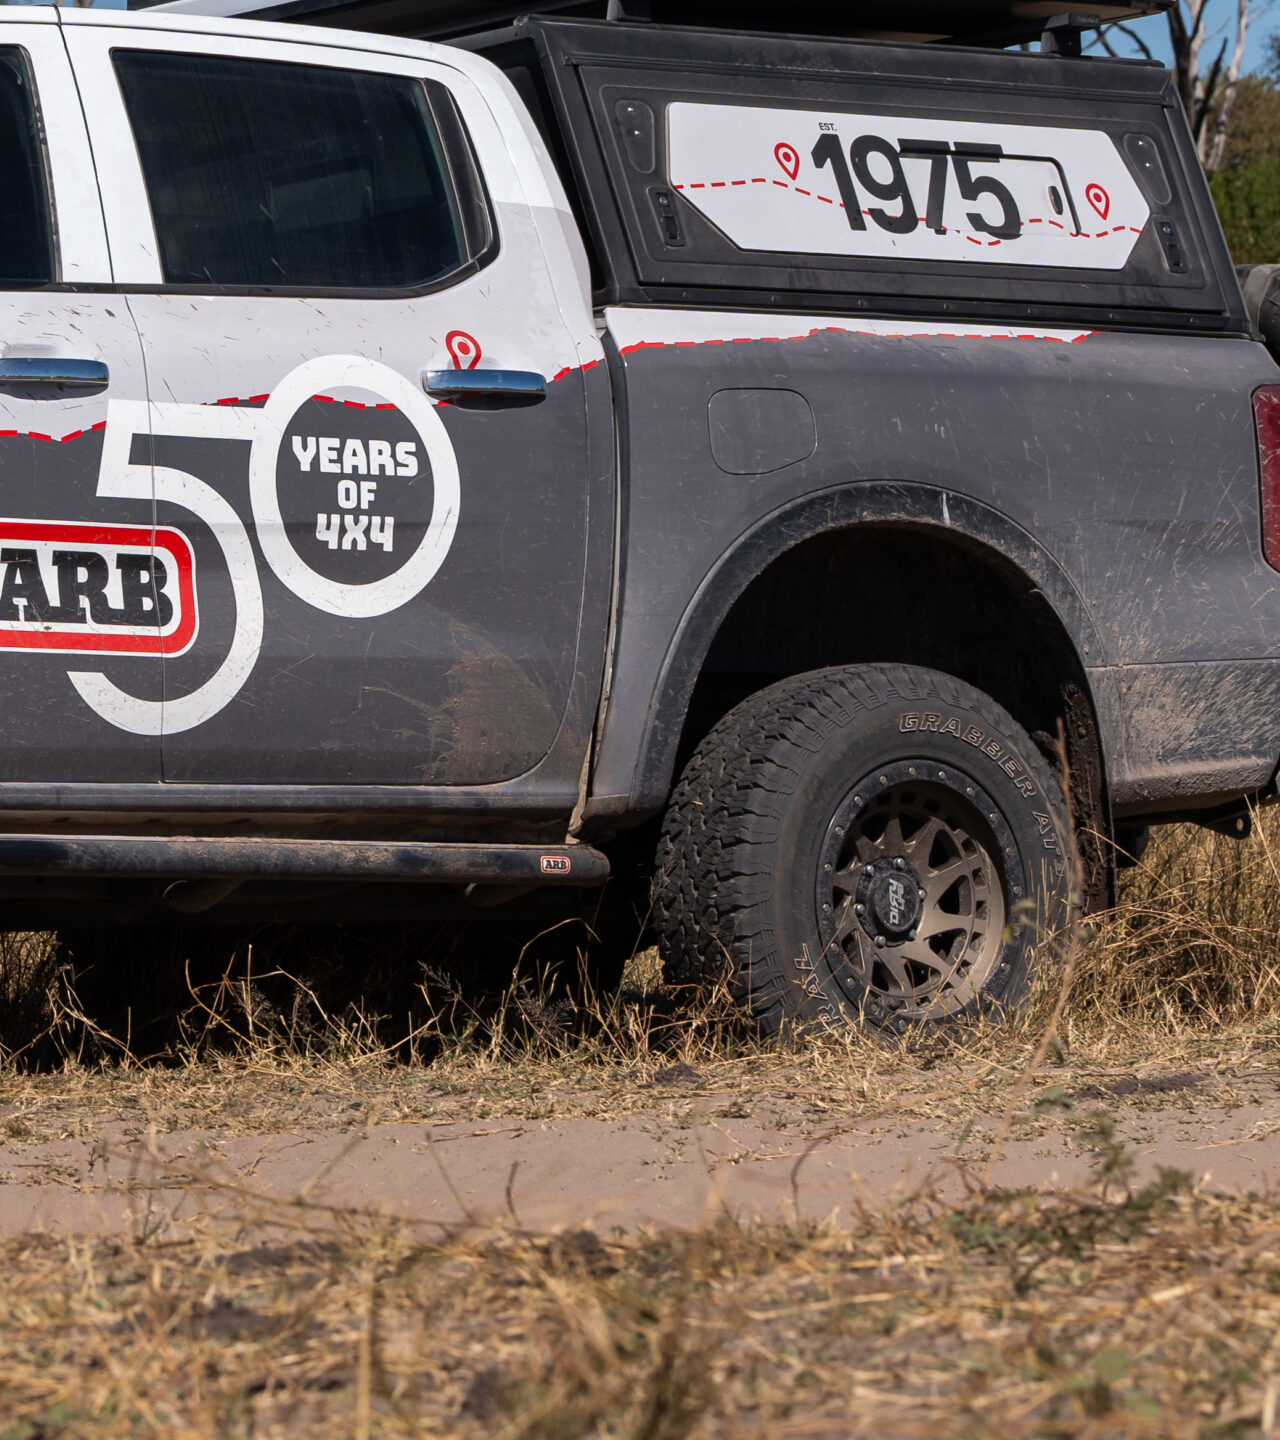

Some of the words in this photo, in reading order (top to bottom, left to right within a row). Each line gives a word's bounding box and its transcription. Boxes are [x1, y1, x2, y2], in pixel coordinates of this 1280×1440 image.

[818, 122, 837, 131] EST.
[811, 134, 1022, 240] 1975
[292, 435, 419, 477] YEARS
[337, 479, 377, 509] OF
[315, 513, 395, 552] 4X4
[899, 712, 1037, 799] GRABBER
[545, 860, 568, 869] ARB
[889, 878, 899, 924] DIRTY
